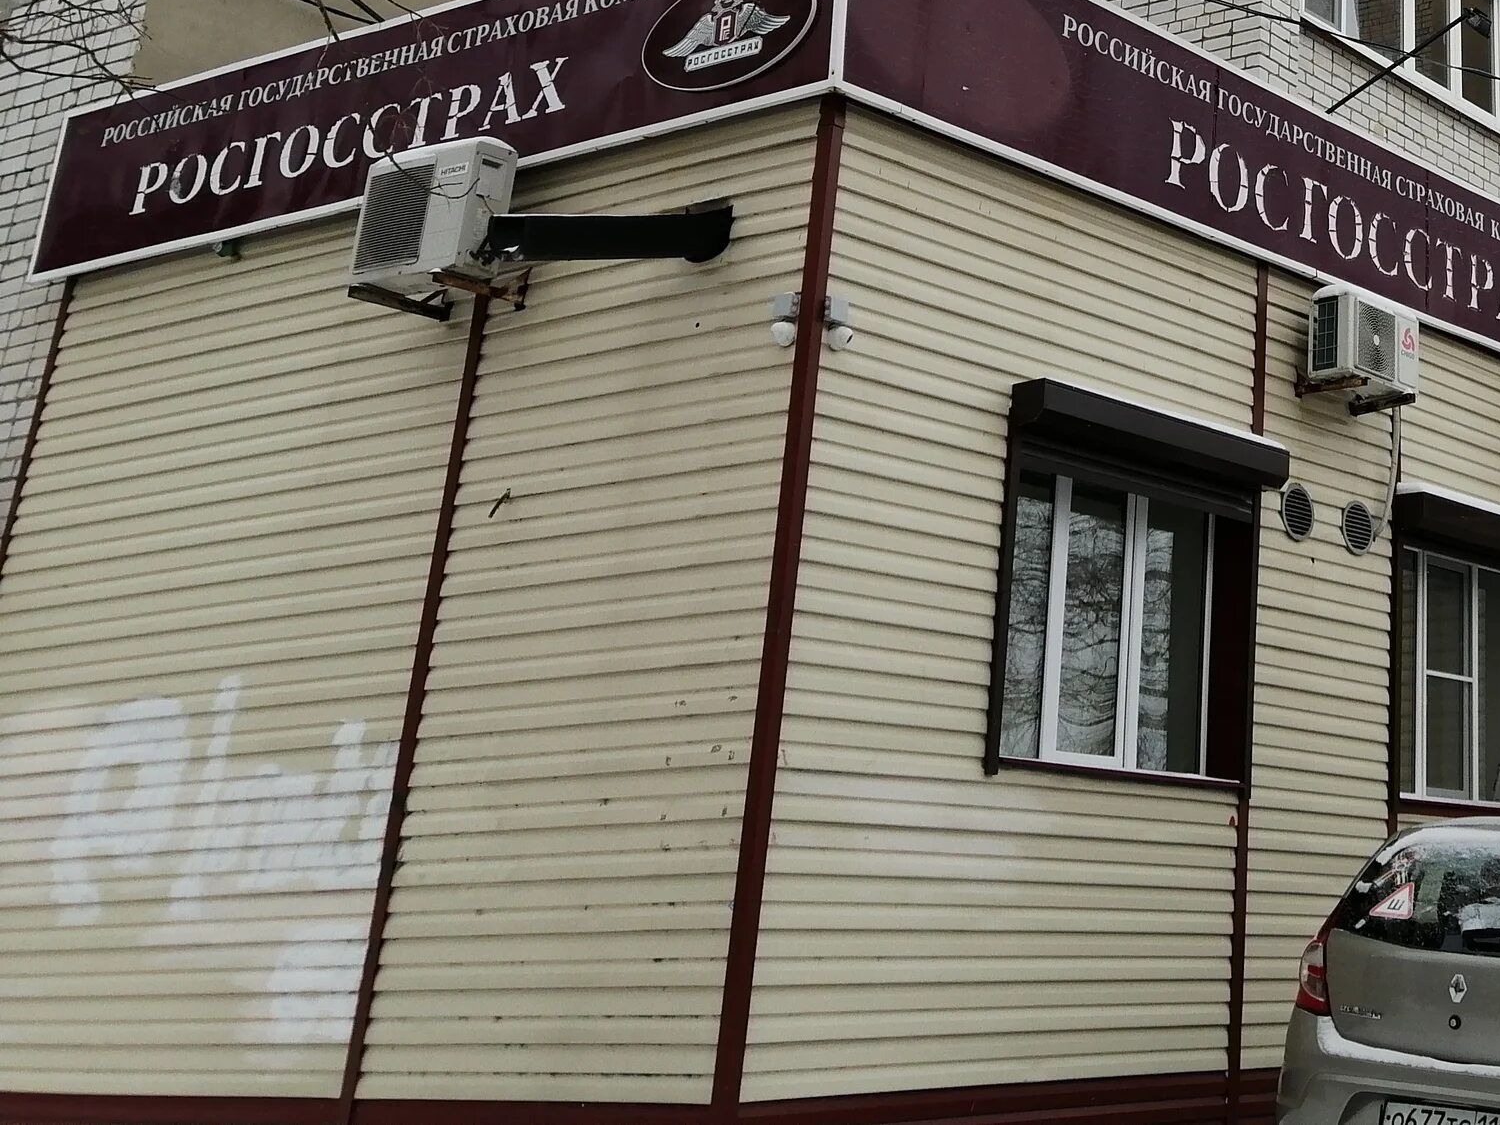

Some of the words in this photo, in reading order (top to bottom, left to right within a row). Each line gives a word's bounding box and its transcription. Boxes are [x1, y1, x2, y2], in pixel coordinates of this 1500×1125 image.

[100, 93, 234, 148] РОССИЙСКАЯ
[237, 35, 444, 111] ГОСУДАРСТВЕННАЯ
[686, 39, 761, 69] РОСГОССТРАХ
[128, 56, 569, 216] РОСГОССТРАХ
[440, 164, 467, 176] HITACHI
[1061, 14, 1212, 104] РОССИЙСКАЯ
[1216, 87, 1392, 191] ГОСУДАРСТВЕННАЯ
[1395, 176, 1485, 232] СТРАХОВАЯ
